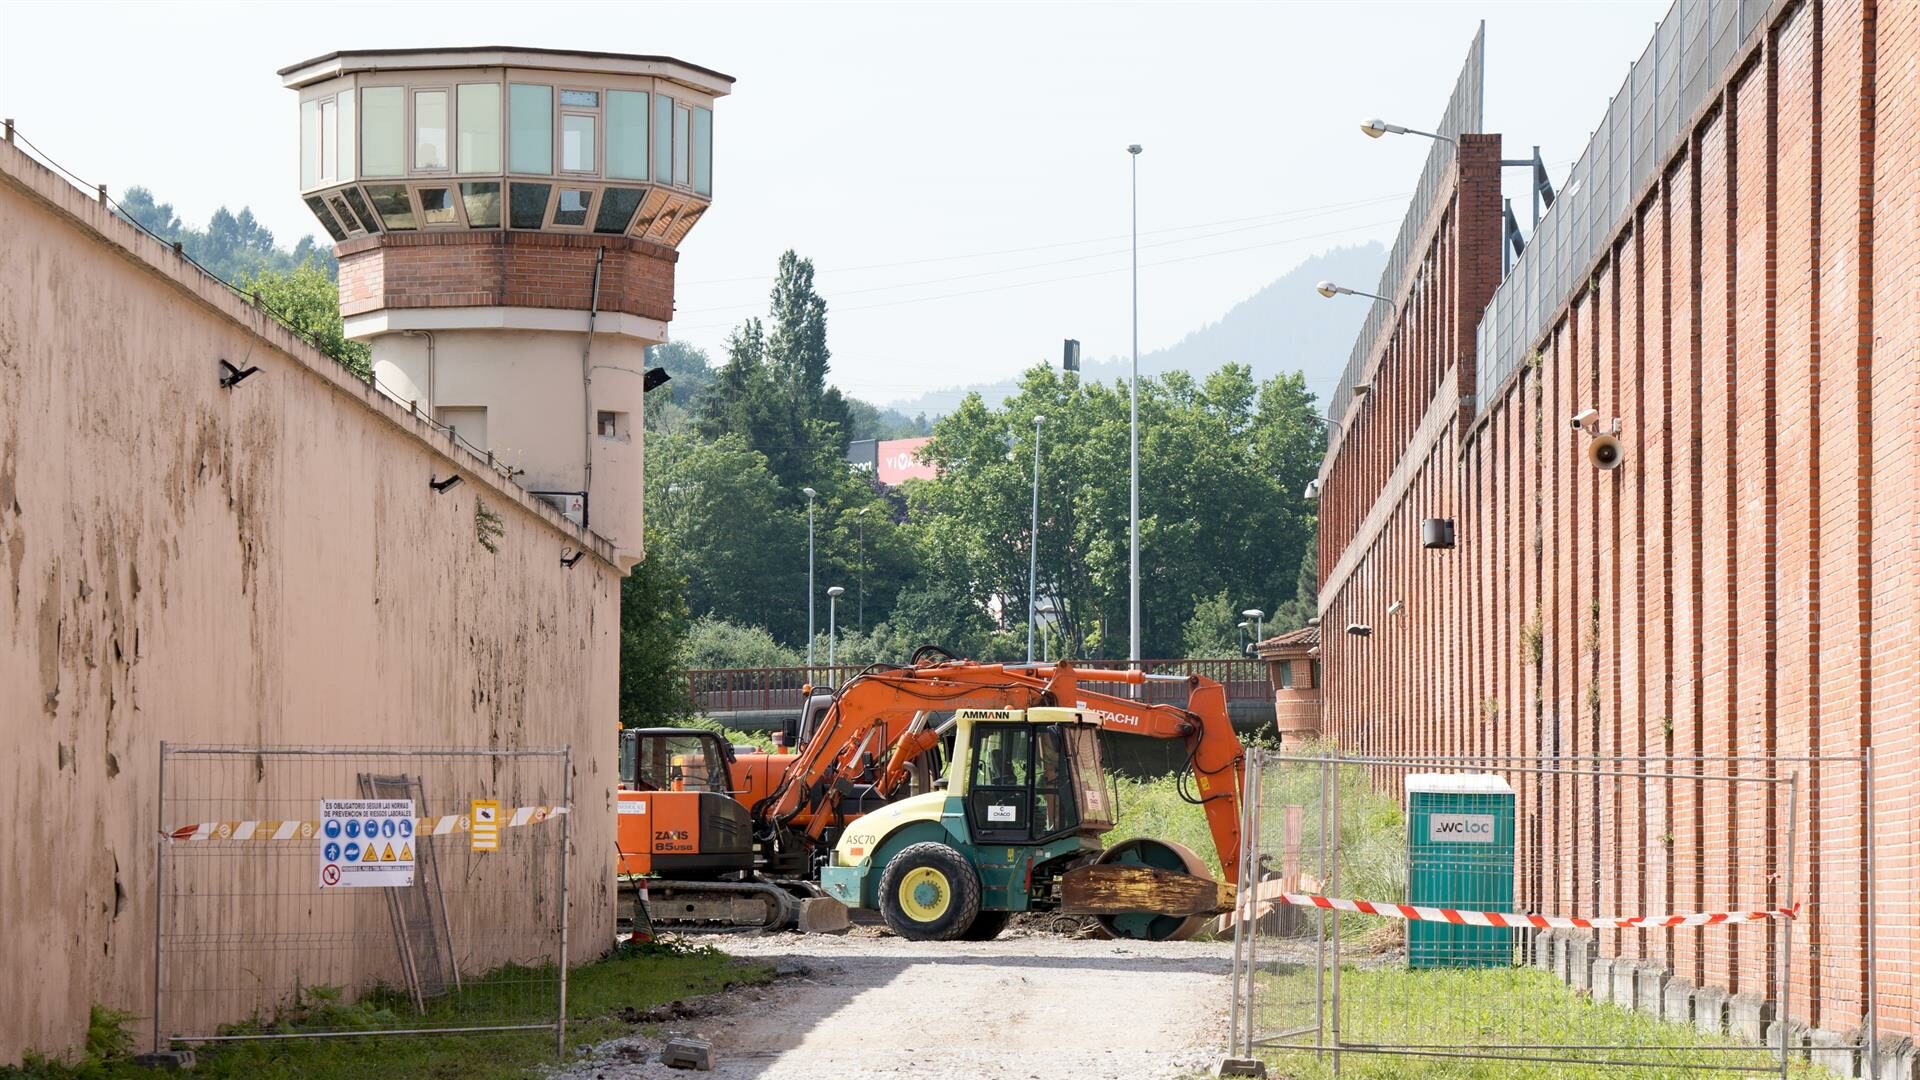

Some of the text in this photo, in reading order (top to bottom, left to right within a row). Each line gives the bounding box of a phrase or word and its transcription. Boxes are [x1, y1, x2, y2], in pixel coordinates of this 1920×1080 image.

[962, 711, 1010, 719] AMMANN
[1087, 707, 1139, 726] TACHI
[325, 802, 332, 810] ES
[333, 802, 366, 810] OBLIGATORIO
[382, 802, 391, 810] LAS
[391, 802, 409, 810] NORMAS
[324, 810, 331, 818] DE
[362, 810, 369, 818] DE
[369, 810, 387, 818] RIESGOS
[387, 810, 412, 818] LABORALES
[655, 831, 688, 841] ZAXIS
[846, 834, 876, 845] ASC70
